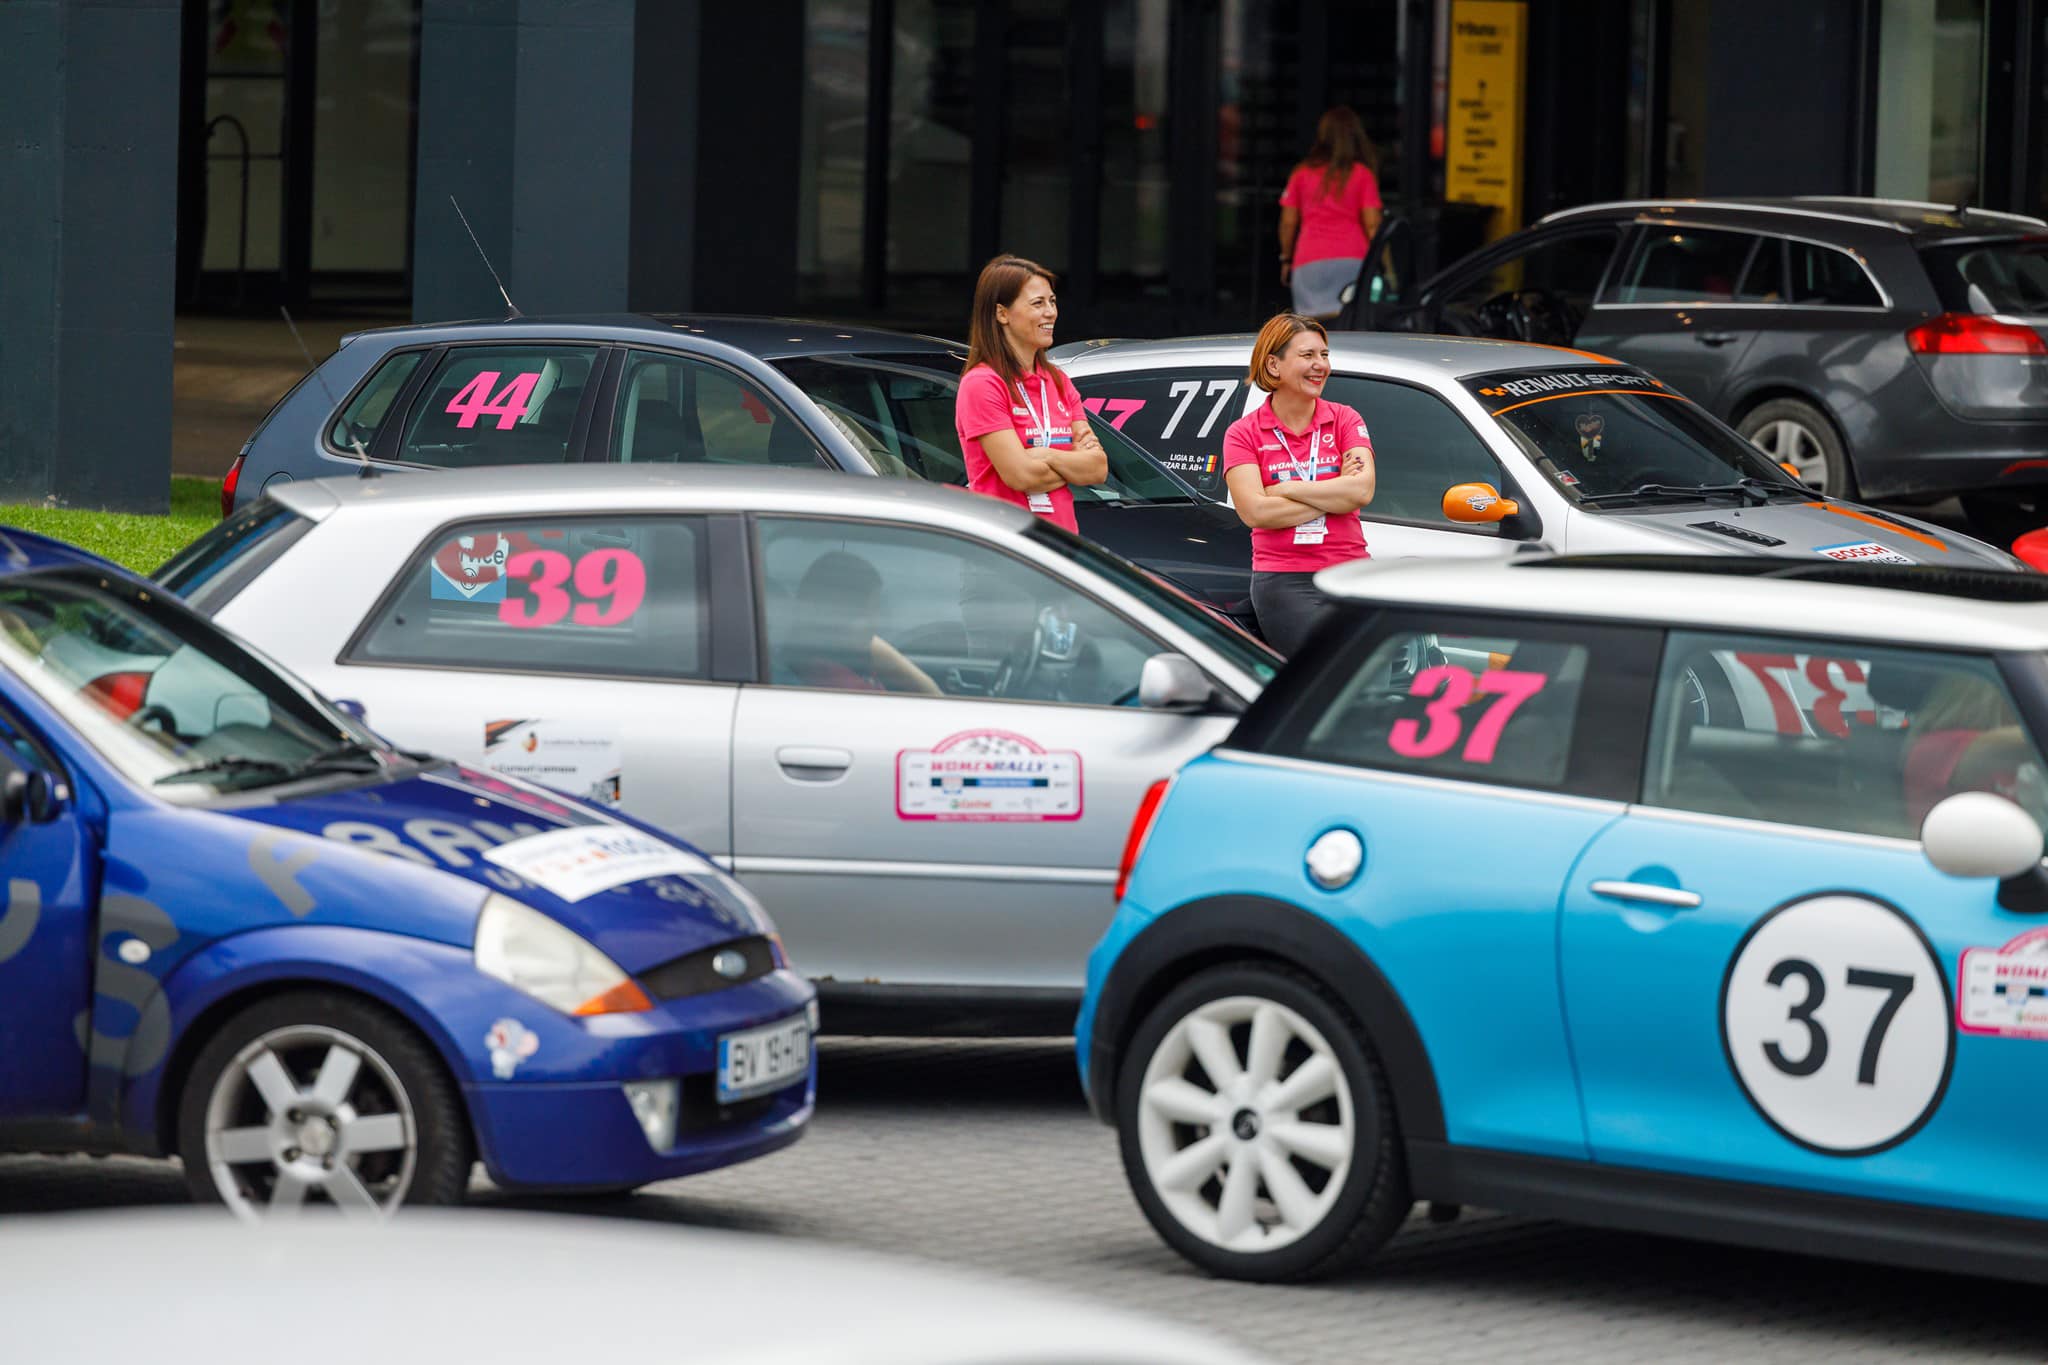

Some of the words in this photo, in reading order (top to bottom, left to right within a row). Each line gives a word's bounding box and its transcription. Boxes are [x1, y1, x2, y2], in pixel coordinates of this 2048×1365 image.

[445, 371, 540, 430] 44
[1161, 380, 1239, 439] 77
[1501, 373, 1589, 397] RENAULT
[1585, 374, 1651, 386] SPORT
[1170, 454, 1188, 462] LIGIA
[1826, 545, 1889, 560] BOSCH
[497, 548, 647, 628] 39
[1388, 664, 1548, 764] 37
[1761, 957, 1916, 1087] 37
[732, 1039, 760, 1083] BV
